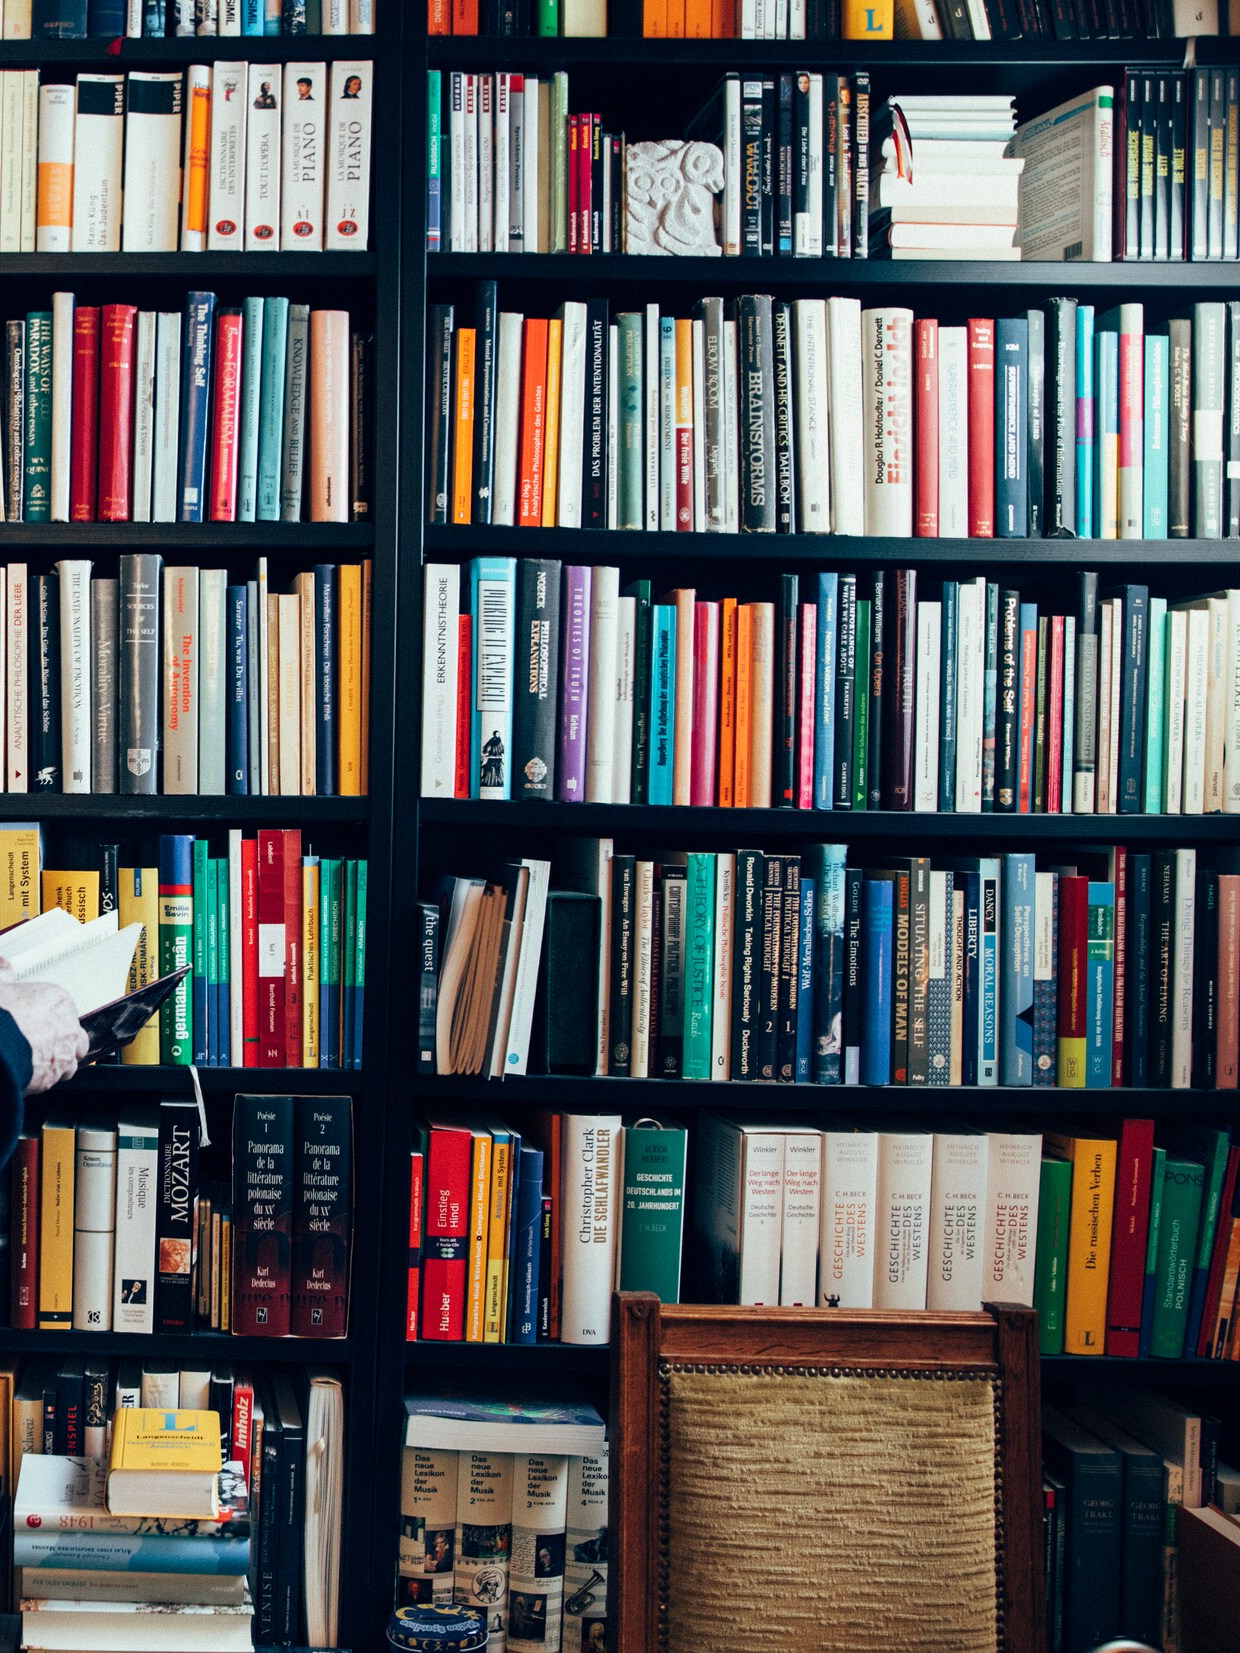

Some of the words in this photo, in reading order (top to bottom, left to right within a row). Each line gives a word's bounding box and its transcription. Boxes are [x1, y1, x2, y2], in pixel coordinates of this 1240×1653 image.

[865, 9, 882, 32] L
[114, 84, 123, 114] PIPER
[173, 83, 181, 114] PIPER
[302, 123, 315, 182] PIANO
[347, 121, 361, 181] PIANO
[1100, 119, 1111, 158] Arabisch
[1158, 155, 1167, 177] BETTY
[198, 303, 208, 321] The
[194, 324, 207, 365] Thinking
[776, 313, 786, 360] DENNETT
[592, 320, 602, 394] INTENTIONALITÄT
[195, 367, 206, 387] Self
[777, 363, 786, 387] AND
[534, 385, 542, 412] Geistes
[593, 397, 601, 414] DER
[777, 389, 787, 405] HIS
[592, 416, 601, 457] PROBLEM
[749, 371, 764, 506] BRAINSTORMS
[778, 407, 788, 446] CRITICS
[533, 429, 541, 472] Philosophie
[592, 460, 600, 477] DAS
[779, 452, 790, 504] DAHLBOM
[532, 474, 540, 516] Analytische
[537, 572, 546, 609] NOZICK
[436, 577, 447, 684] ERKENNTNISTHEORIE
[573, 587, 582, 644] THEORIES
[874, 612, 882, 642] Williams
[1004, 598, 1016, 649] Problems
[183, 635, 192, 654] The
[529, 620, 540, 694] EXPLANATIONS
[573, 649, 581, 662] OF
[875, 652, 883, 665] On
[173, 656, 180, 667] of
[538, 621, 550, 700] PHILOSOPHICAL
[1004, 654, 1015, 666] of
[183, 659, 192, 712] Invention
[571, 668, 580, 702] TRUTH
[872, 668, 882, 696] Opera
[1004, 668, 1015, 687] the
[169, 672, 180, 730] Autonomy
[1004, 690, 1014, 714] Self
[570, 714, 579, 740] Kirkham
[21, 851, 30, 886] System
[21, 891, 29, 907] mit
[745, 887, 754, 921] Dworkin
[900, 877, 908, 908] HOLLIS
[426, 916, 436, 935] the
[850, 919, 859, 938] The
[968, 909, 976, 958] LIBERTY
[423, 939, 435, 971] quest
[743, 928, 753, 955] Taking
[896, 914, 909, 974] MODELS
[915, 904, 926, 978] SITUATING
[743, 956, 752, 983] Rights
[850, 941, 859, 986] Emotions
[742, 985, 751, 1023] Seriously
[897, 979, 908, 999] OF
[915, 984, 925, 1011] THE
[896, 1003, 907, 1041] MAN
[914, 1018, 924, 1048] SELF
[742, 1030, 750, 1074] Duckworth
[257, 1112, 276, 1121] Poésie
[248, 1141, 284, 1155] Panorama
[582, 1128, 594, 1162] Clark
[170, 1125, 189, 1223] MOZART
[247, 1172, 283, 1185] littérature
[256, 1158, 265, 1169] de
[268, 1158, 274, 1169] la
[594, 1129, 610, 1221] SCHLAFWANDLER
[637, 1173, 673, 1183] GESCHICHTE
[1088, 1154, 1102, 1189] Verben
[138, 1167, 149, 1209] Musique
[248, 1187, 282, 1201] polonaise
[627, 1188, 673, 1196] DEUTSCHLANDS
[674, 1188, 681, 1196] IM
[437, 1190, 449, 1228] Einstieg
[450, 1202, 460, 1228] Hindi
[580, 1167, 594, 1244] Christopher
[638, 1201, 679, 1211] JAHRHUNDERT
[847, 1204, 855, 1224] DES
[1087, 1194, 1100, 1247] russischen
[253, 1218, 275, 1231] siècle
[594, 1226, 607, 1244] DIE
[857, 1204, 866, 1257] WESTENS
[833, 1204, 844, 1279] GESCHICHTE
[257, 1267, 269, 1276] Karl
[1086, 1252, 1097, 1269] Die
[252, 1278, 276, 1288] Dedecius
[1176, 1260, 1187, 1309] POLNISCH
[440, 1293, 450, 1332] Hueber
[159, 1413, 195, 1430] L
[235, 1396, 249, 1449] Imholz
[414, 1470, 444, 1478] Lexikon
[415, 1462, 434, 1470] neue
[414, 1486, 438, 1494] Musik
[60, 1516, 94, 1528] 1948
